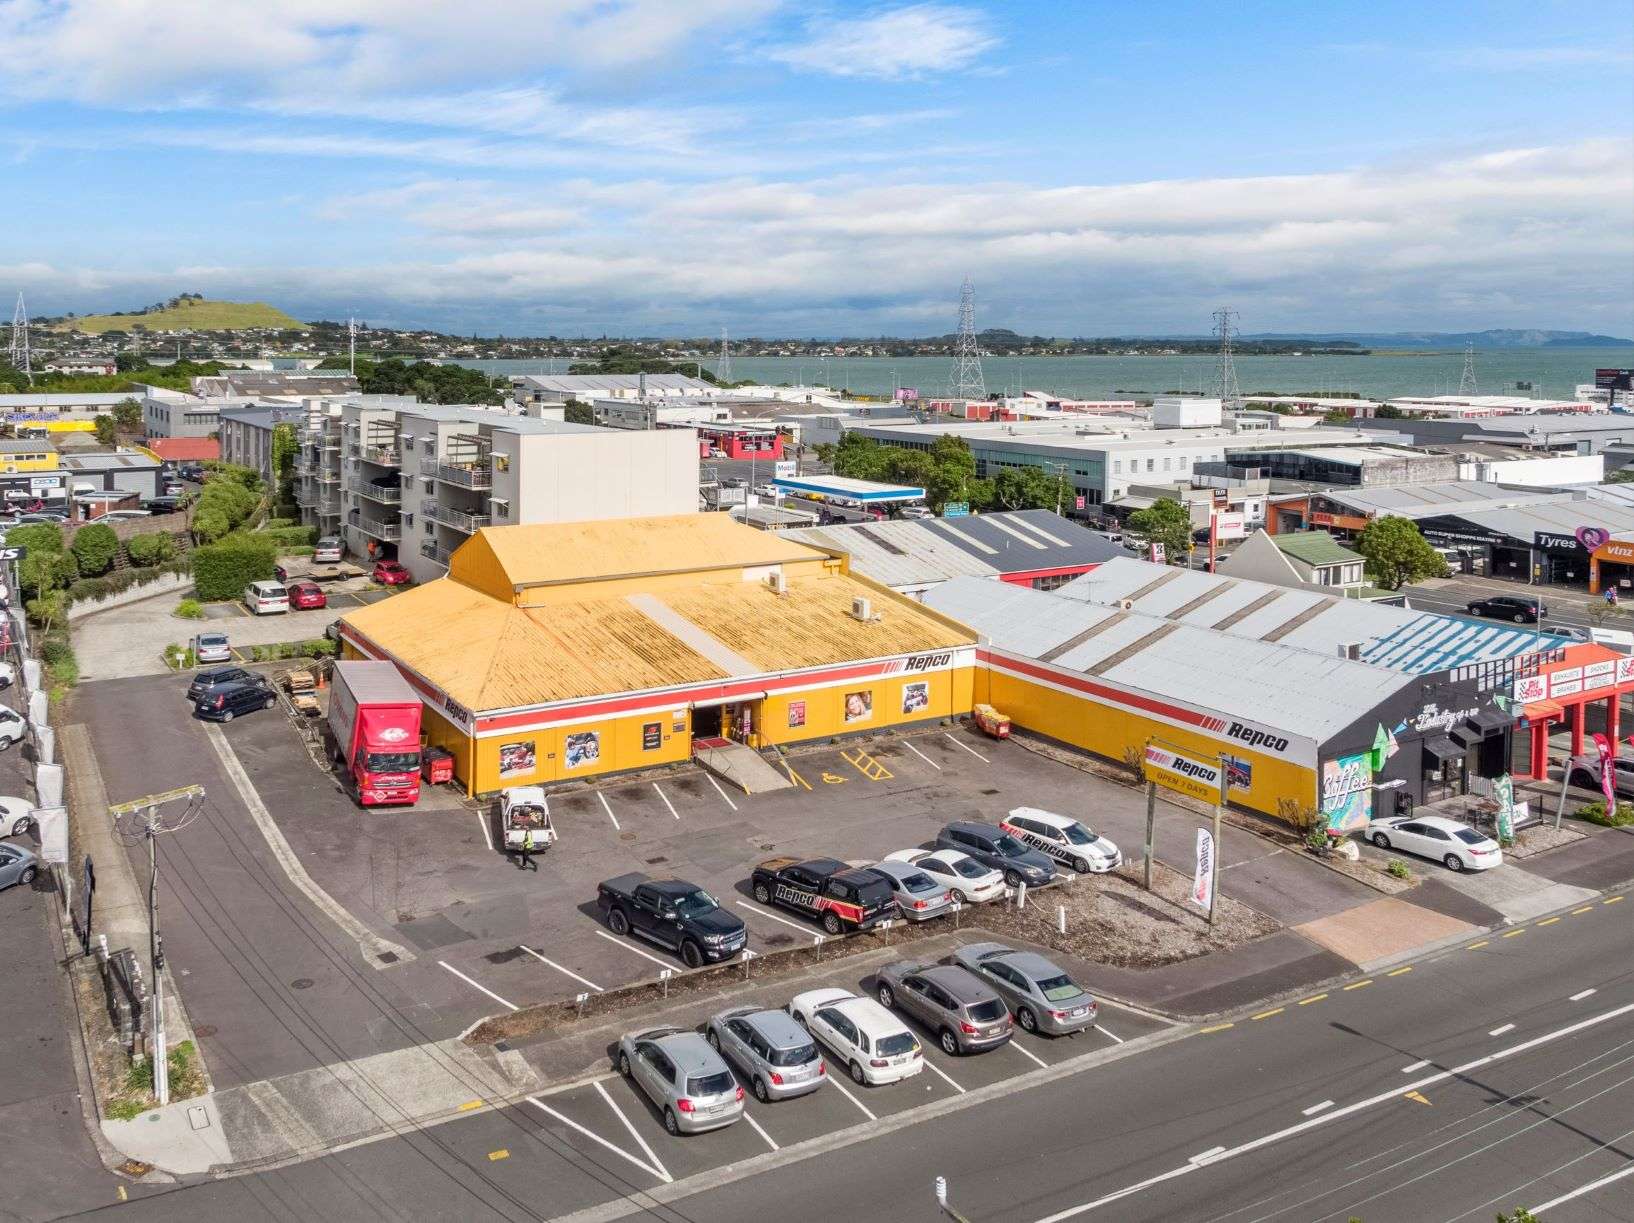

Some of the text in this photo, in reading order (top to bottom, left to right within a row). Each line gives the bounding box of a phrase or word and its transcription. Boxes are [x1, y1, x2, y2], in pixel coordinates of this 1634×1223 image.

[1539, 534, 1577, 549] Tyres
[1607, 546, 1633, 557] vtnz
[904, 655, 951, 671] Repco
[1525, 687, 1543, 699] Stop
[1528, 680, 1539, 690] Pit
[445, 697, 468, 724] Repco
[1227, 721, 1289, 752] Repco
[1172, 757, 1217, 782] Repco
[1156, 772, 1179, 786] OPEN
[1187, 783, 1209, 797] DAYS
[1023, 833, 1065, 859] Repco
[776, 884, 816, 906] Repco
